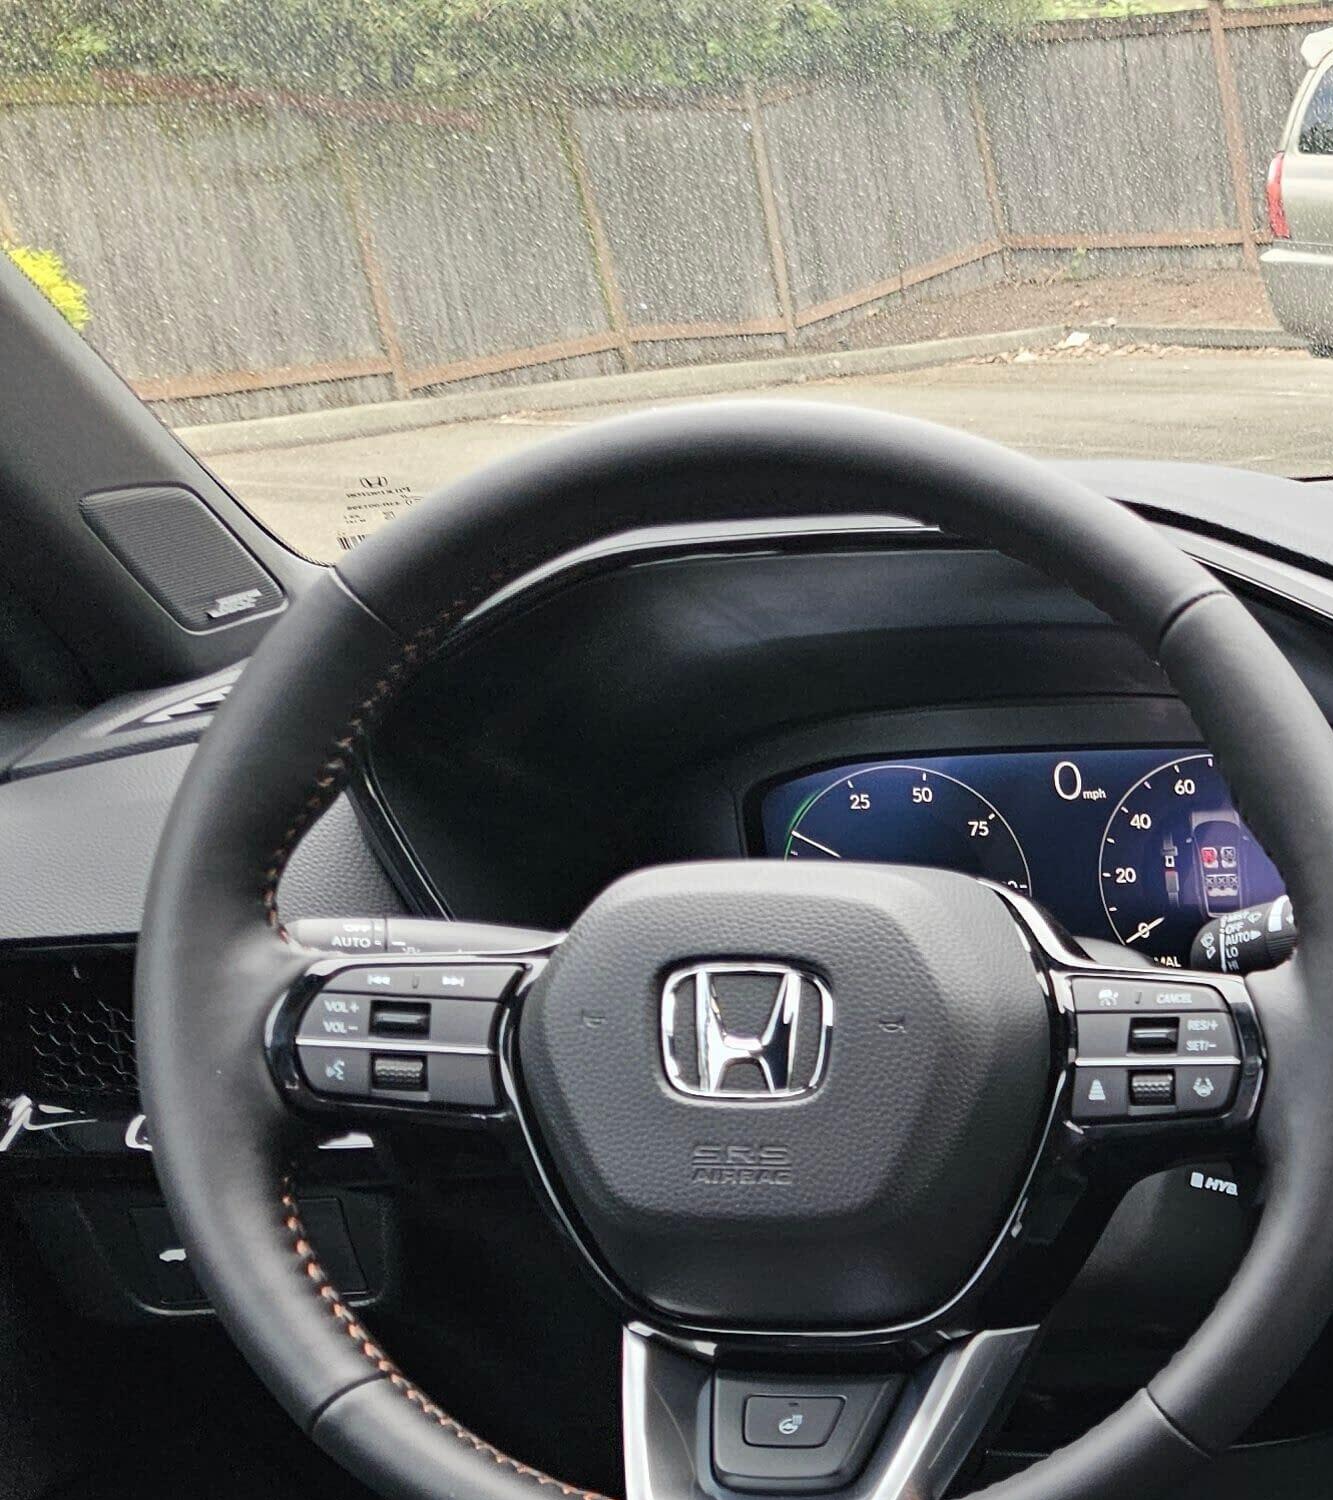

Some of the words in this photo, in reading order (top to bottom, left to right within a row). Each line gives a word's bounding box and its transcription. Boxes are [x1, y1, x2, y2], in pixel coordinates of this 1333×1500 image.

[1053, 760, 1081, 801] 0
[1082, 785, 1107, 803] mph
[1174, 778, 1196, 795] 60
[849, 793, 871, 810] 25
[912, 787, 933, 804] 50
[968, 821, 989, 838] 75
[1130, 813, 1152, 831] 40
[1115, 867, 1137, 884] 20
[331, 935, 371, 948] AUTO
[1225, 931, 1250, 946] AUTO
[1225, 946, 1239, 959] LO
